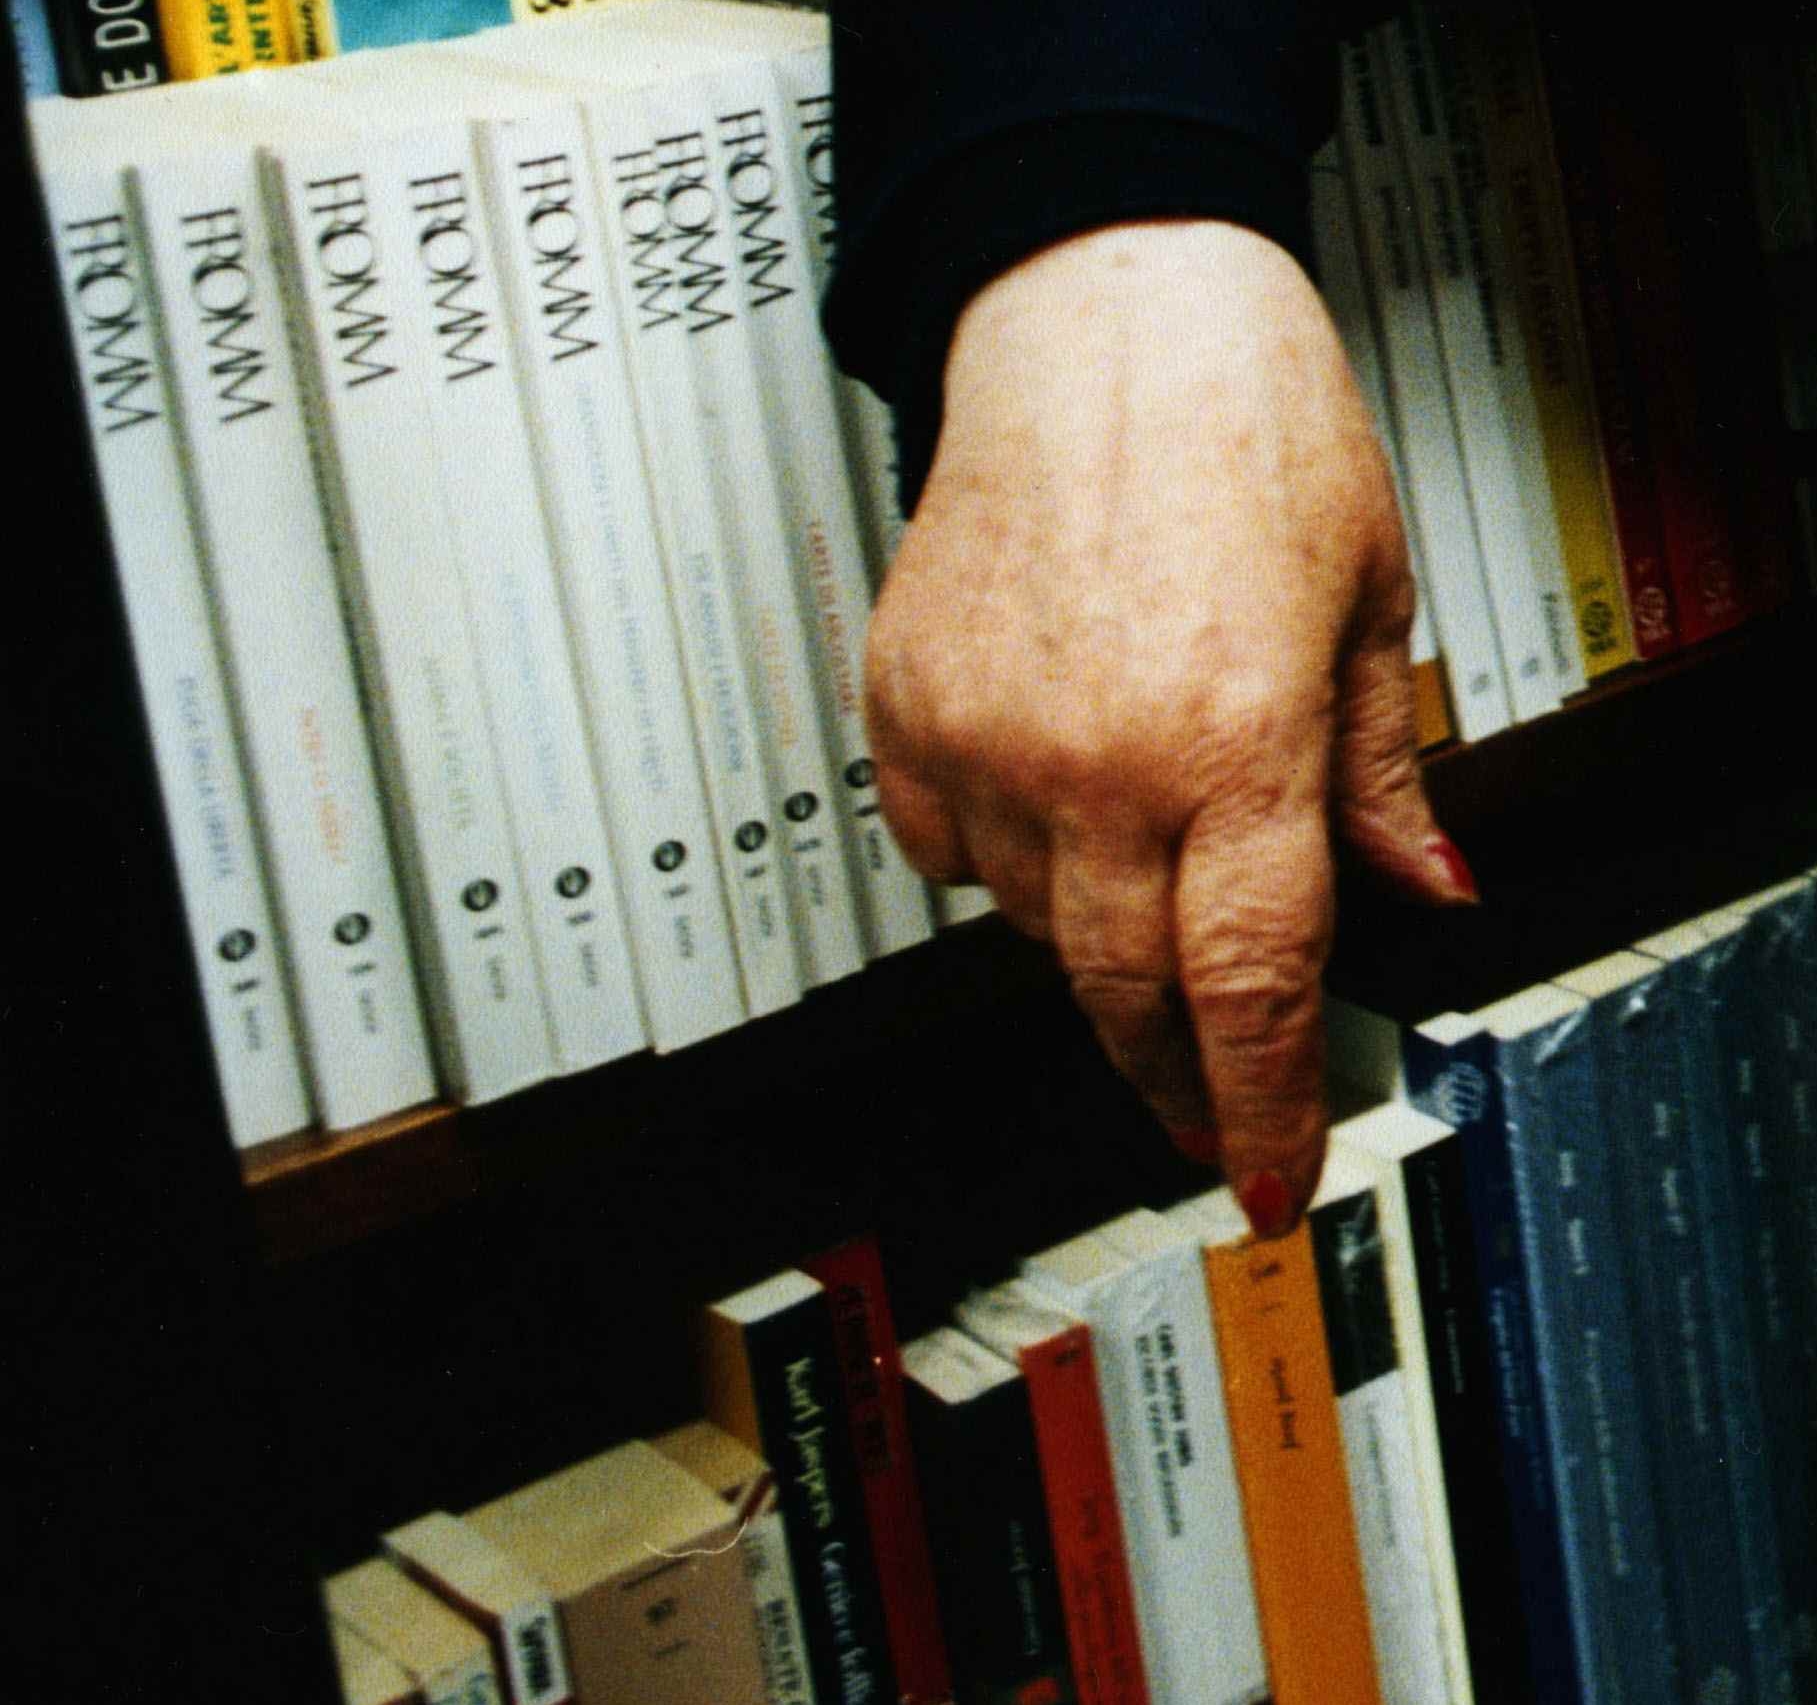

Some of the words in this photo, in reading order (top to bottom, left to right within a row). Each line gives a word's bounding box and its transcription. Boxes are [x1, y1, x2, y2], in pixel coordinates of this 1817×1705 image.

[302, 169, 403, 387] FROMM
[404, 169, 502, 385] FROMM
[510, 152, 605, 365] FROMM
[608, 146, 683, 332] FROMM
[652, 130, 739, 337] FROMM
[713, 107, 798, 310] FROMM
[60, 210, 165, 434] FROMM
[174, 204, 280, 427] FROMM
[781, 1356, 824, 1422] Karl
[783, 1422, 845, 1531] Jaspers
